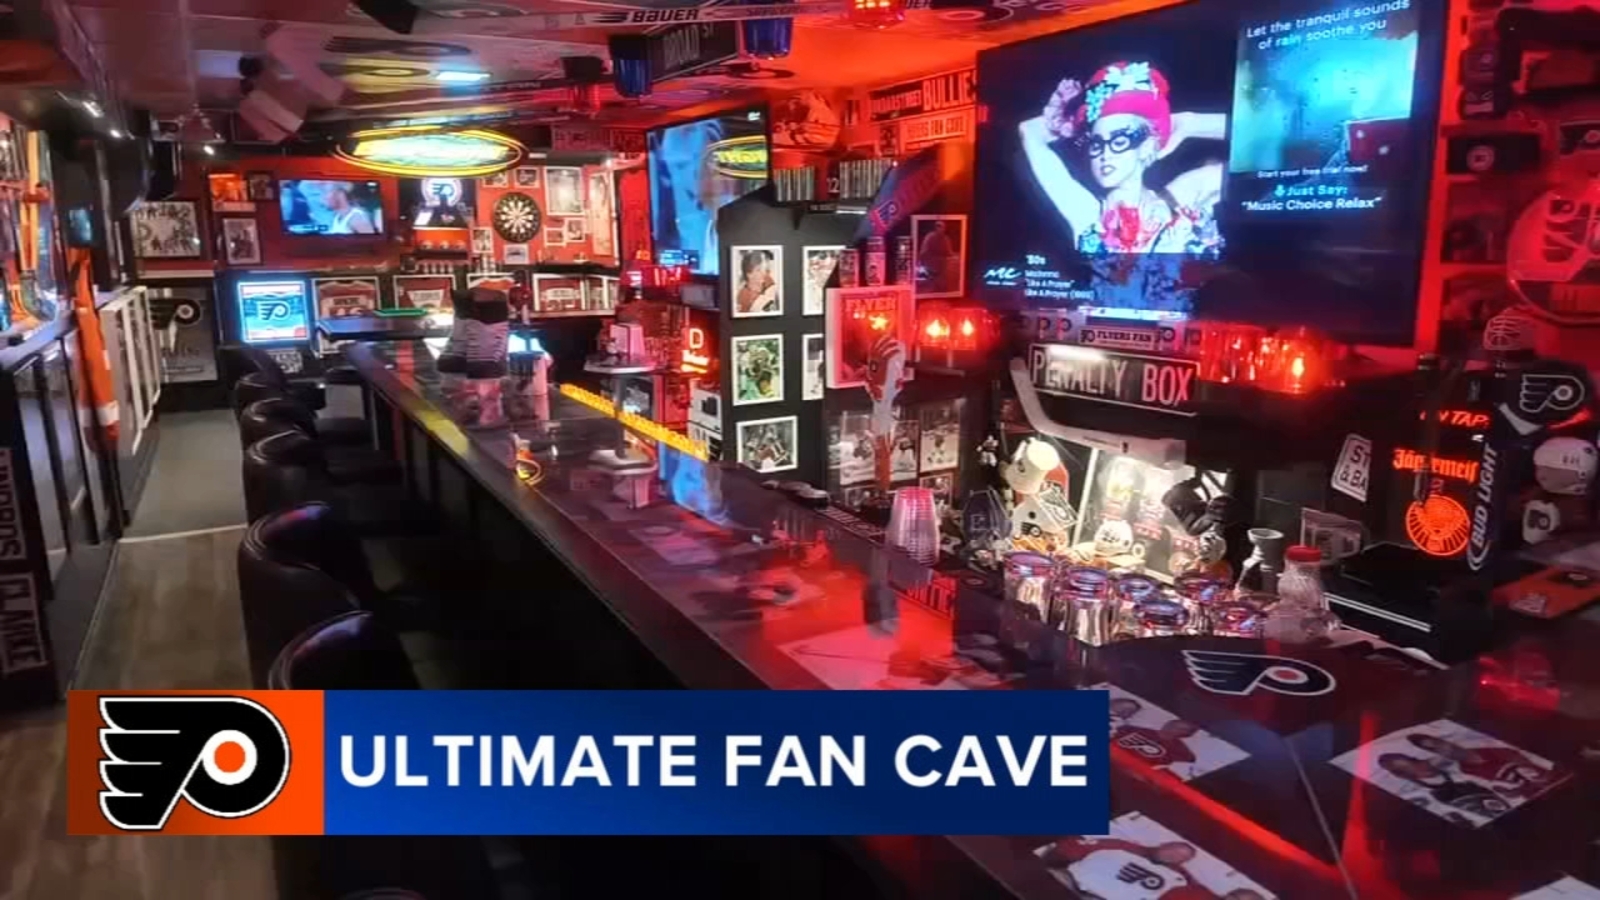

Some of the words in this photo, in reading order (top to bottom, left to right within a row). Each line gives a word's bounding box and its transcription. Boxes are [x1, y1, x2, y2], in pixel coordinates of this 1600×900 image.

[632, 9, 699, 23] BAUER
[1246, 26, 1266, 38] Let
[1270, 21, 1292, 33] the
[1296, 8, 1350, 29] tranquil
[1354, 0, 1411, 18] sounds
[1258, 38, 1272, 50] of
[1275, 33, 1302, 47] rain
[1306, 25, 1355, 42] soothe
[1360, 18, 1388, 35] you
[1257, 170, 1279, 178] Start
[1287, 185, 1314, 196] Just
[1317, 184, 1349, 196] Say:
[1285, 199, 1334, 210] Choice
[1097, 330, 1131, 341] FLYERS
[1132, 333, 1153, 342] FAN
[1032, 349, 1128, 398] PENALTY
[1141, 362, 1194, 407] BOX
[1477, 442, 1498, 503] LIGHT
[1471, 504, 1488, 549] BUD
